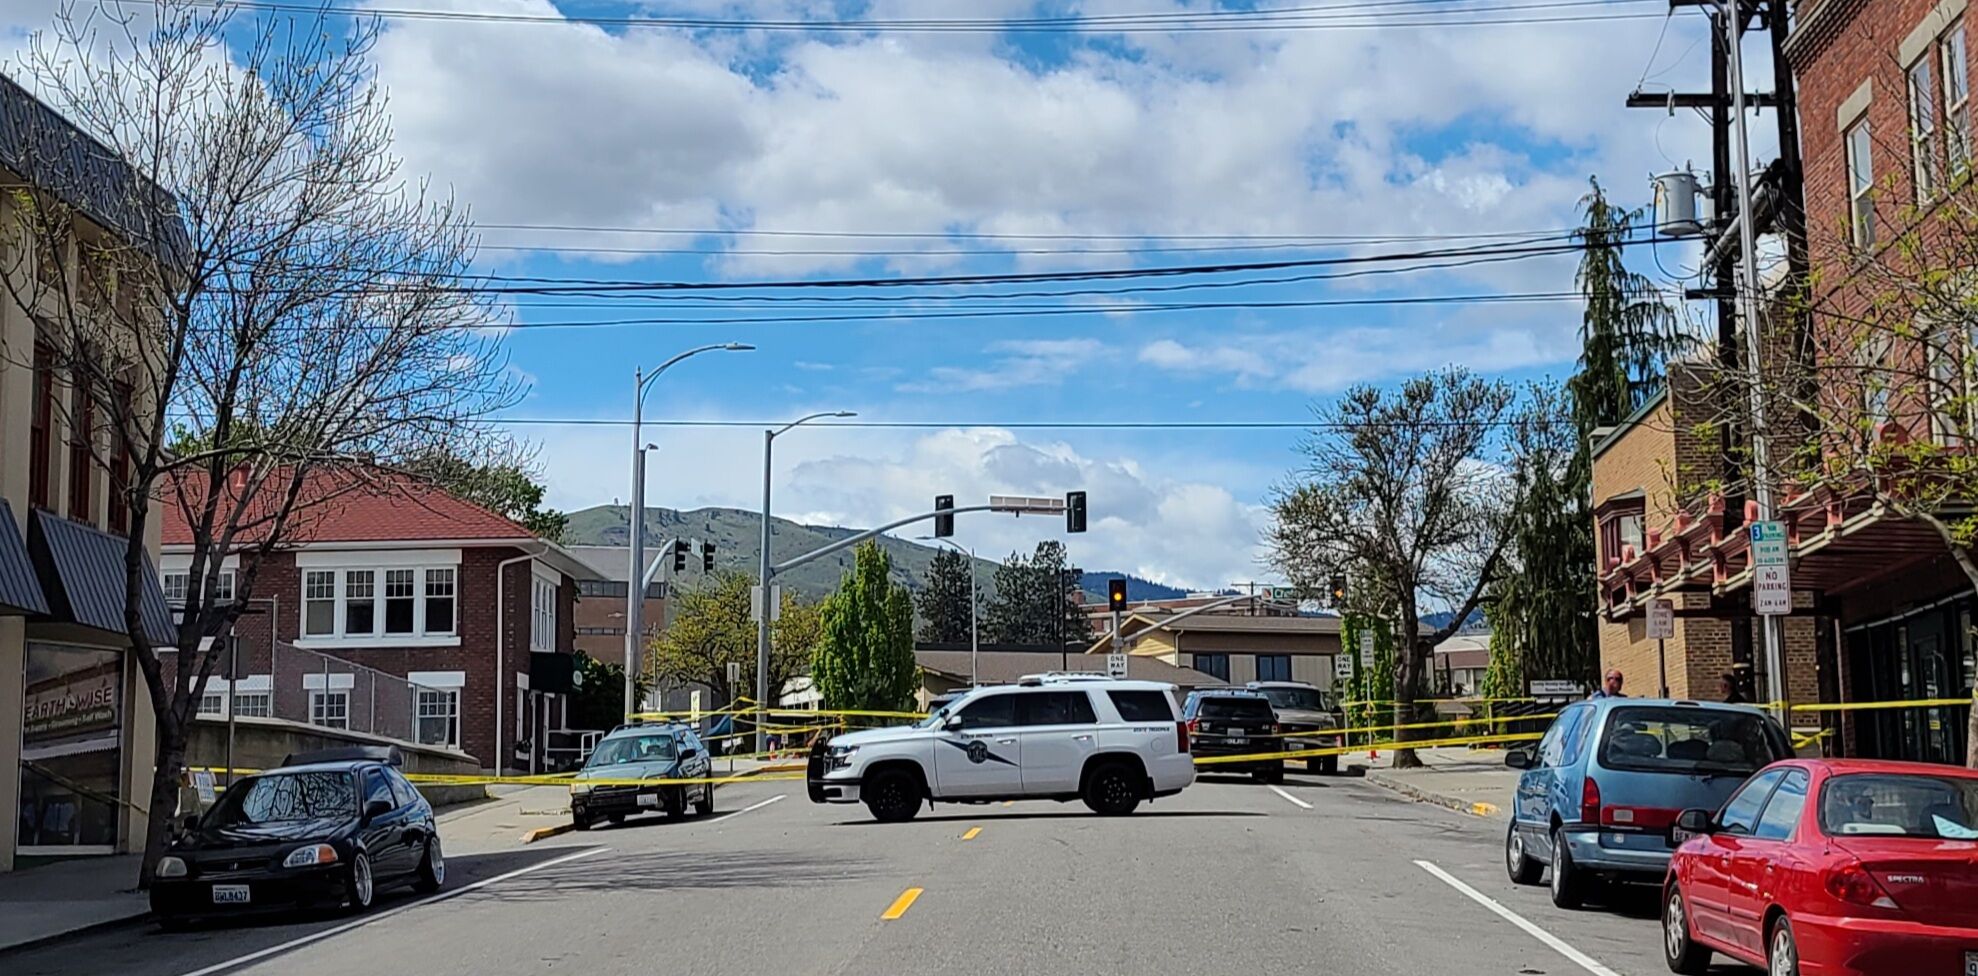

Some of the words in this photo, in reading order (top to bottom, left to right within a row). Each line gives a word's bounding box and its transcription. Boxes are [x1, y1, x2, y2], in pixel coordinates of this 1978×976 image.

[1753, 526, 1760, 539] 3
[1765, 571, 1778, 580] NO
[1758, 582, 1786, 590] PARKING
[26, 697, 66, 719] EARTH
[77, 686, 113, 711] WISE
[1887, 875, 1925, 884] SPECTRA
